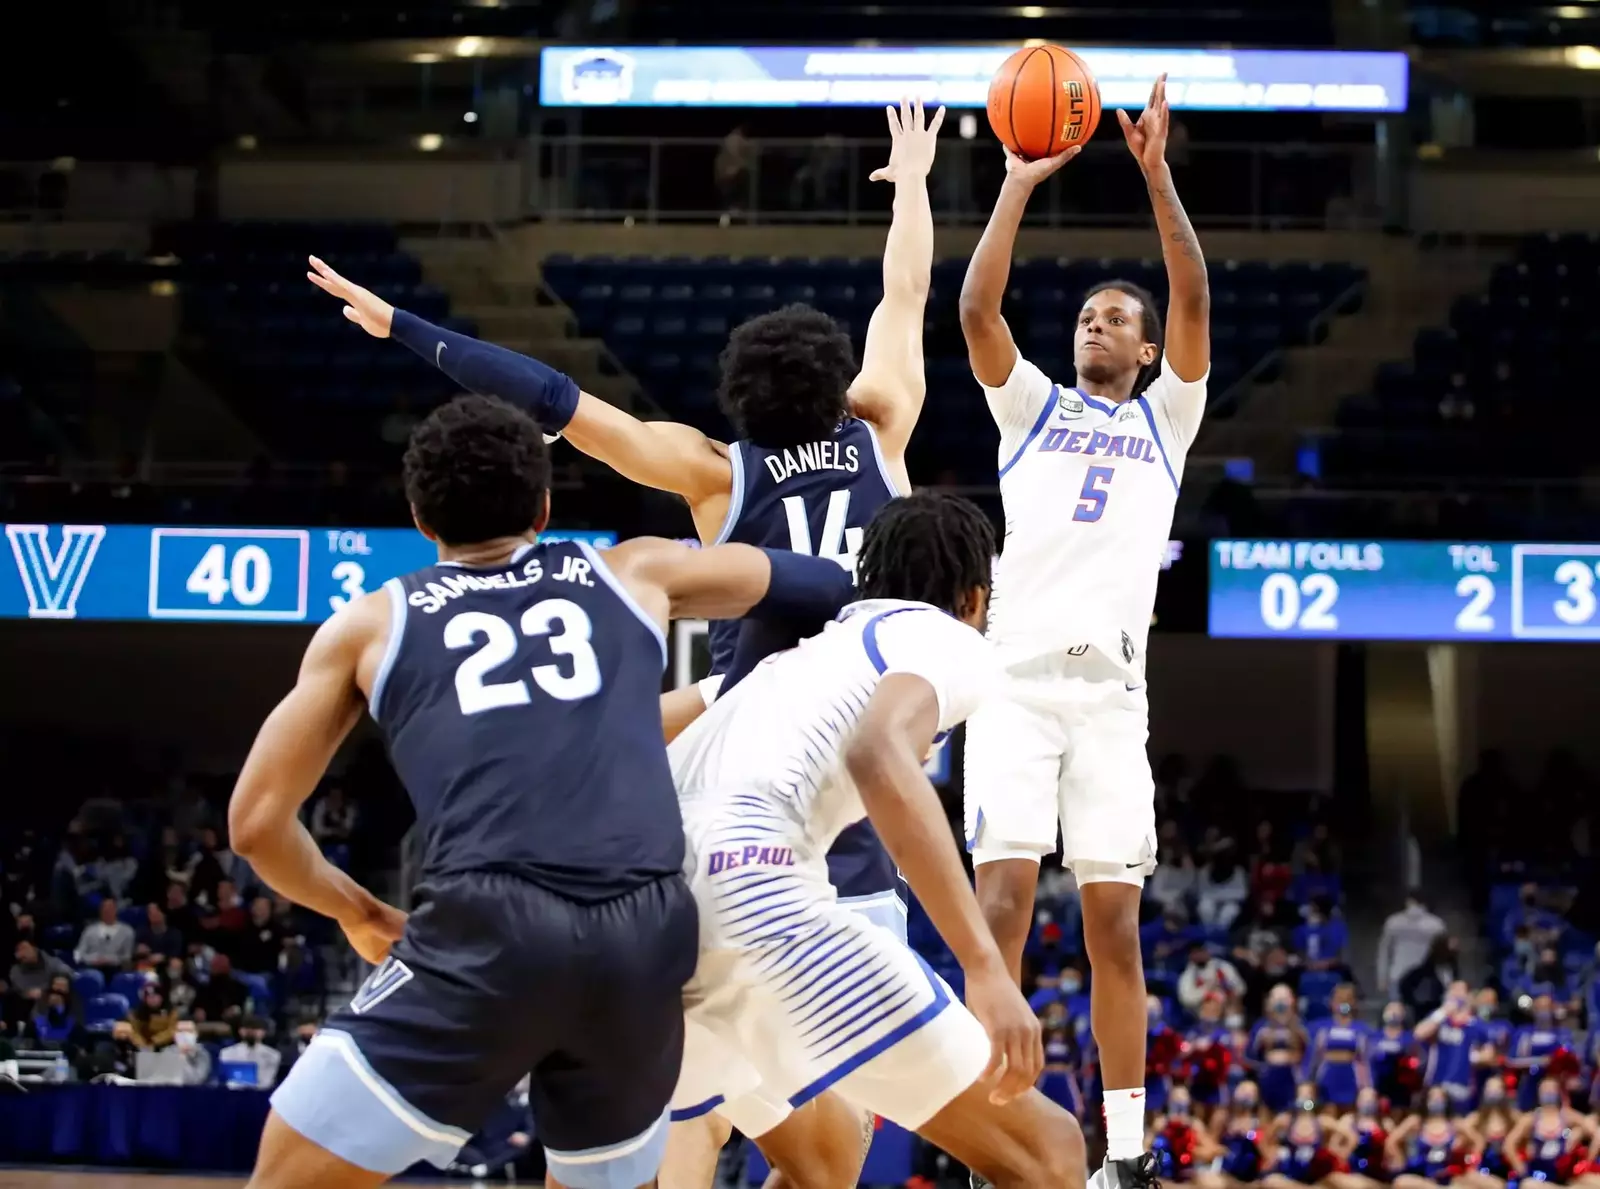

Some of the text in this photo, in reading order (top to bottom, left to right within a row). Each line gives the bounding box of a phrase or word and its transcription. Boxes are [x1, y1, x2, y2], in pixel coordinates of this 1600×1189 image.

[764, 441, 859, 484] DANIELS
[1038, 426, 1156, 464] DEPAUL
[1072, 466, 1115, 523] 5
[781, 489, 866, 587] 14
[1216, 542, 1290, 570] TEAM
[1295, 542, 1383, 571] FOULS
[186, 544, 272, 605] 40
[331, 562, 364, 612] 3
[409, 555, 595, 614] SAMUELS JR.
[1260, 572, 1339, 631] 02
[1454, 574, 1496, 632] 2
[1553, 560, 1600, 624] 3
[444, 598, 602, 716] 23
[708, 845, 796, 876] DEPAUL
